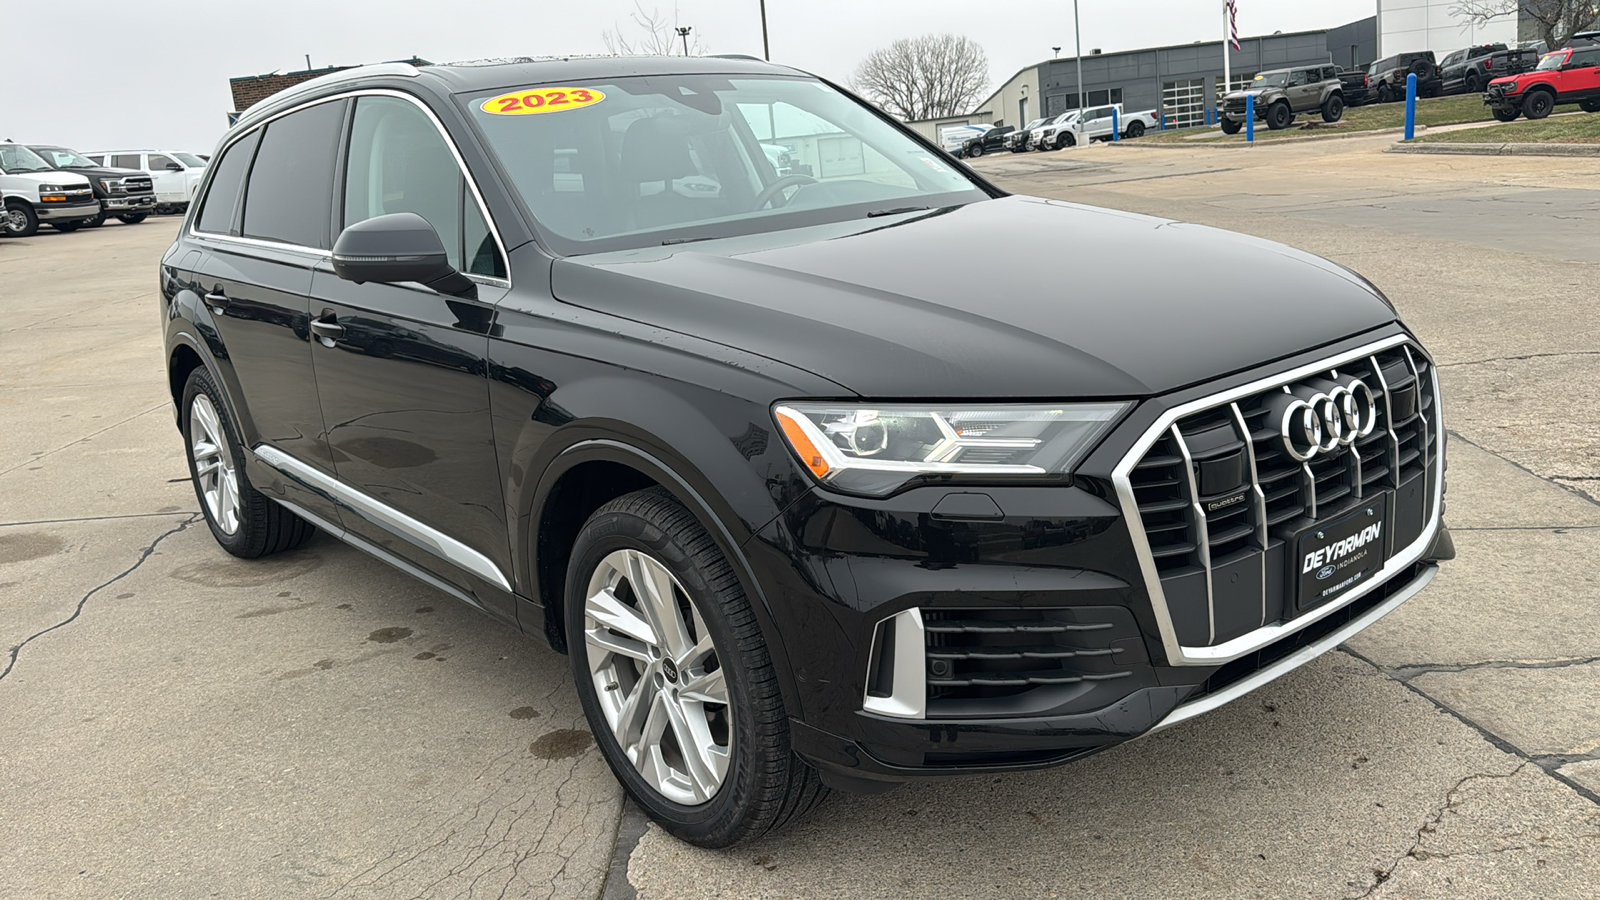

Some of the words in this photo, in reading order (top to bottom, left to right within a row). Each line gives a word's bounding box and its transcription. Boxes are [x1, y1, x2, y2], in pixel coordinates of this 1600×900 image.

[498, 90, 594, 112] 2023
[1211, 494, 1244, 511] quattro
[1302, 521, 1382, 574] DEYARMAN
[1337, 549, 1368, 571] INDIANOLA
[1322, 572, 1362, 597] DEYARMANFORD.COM
